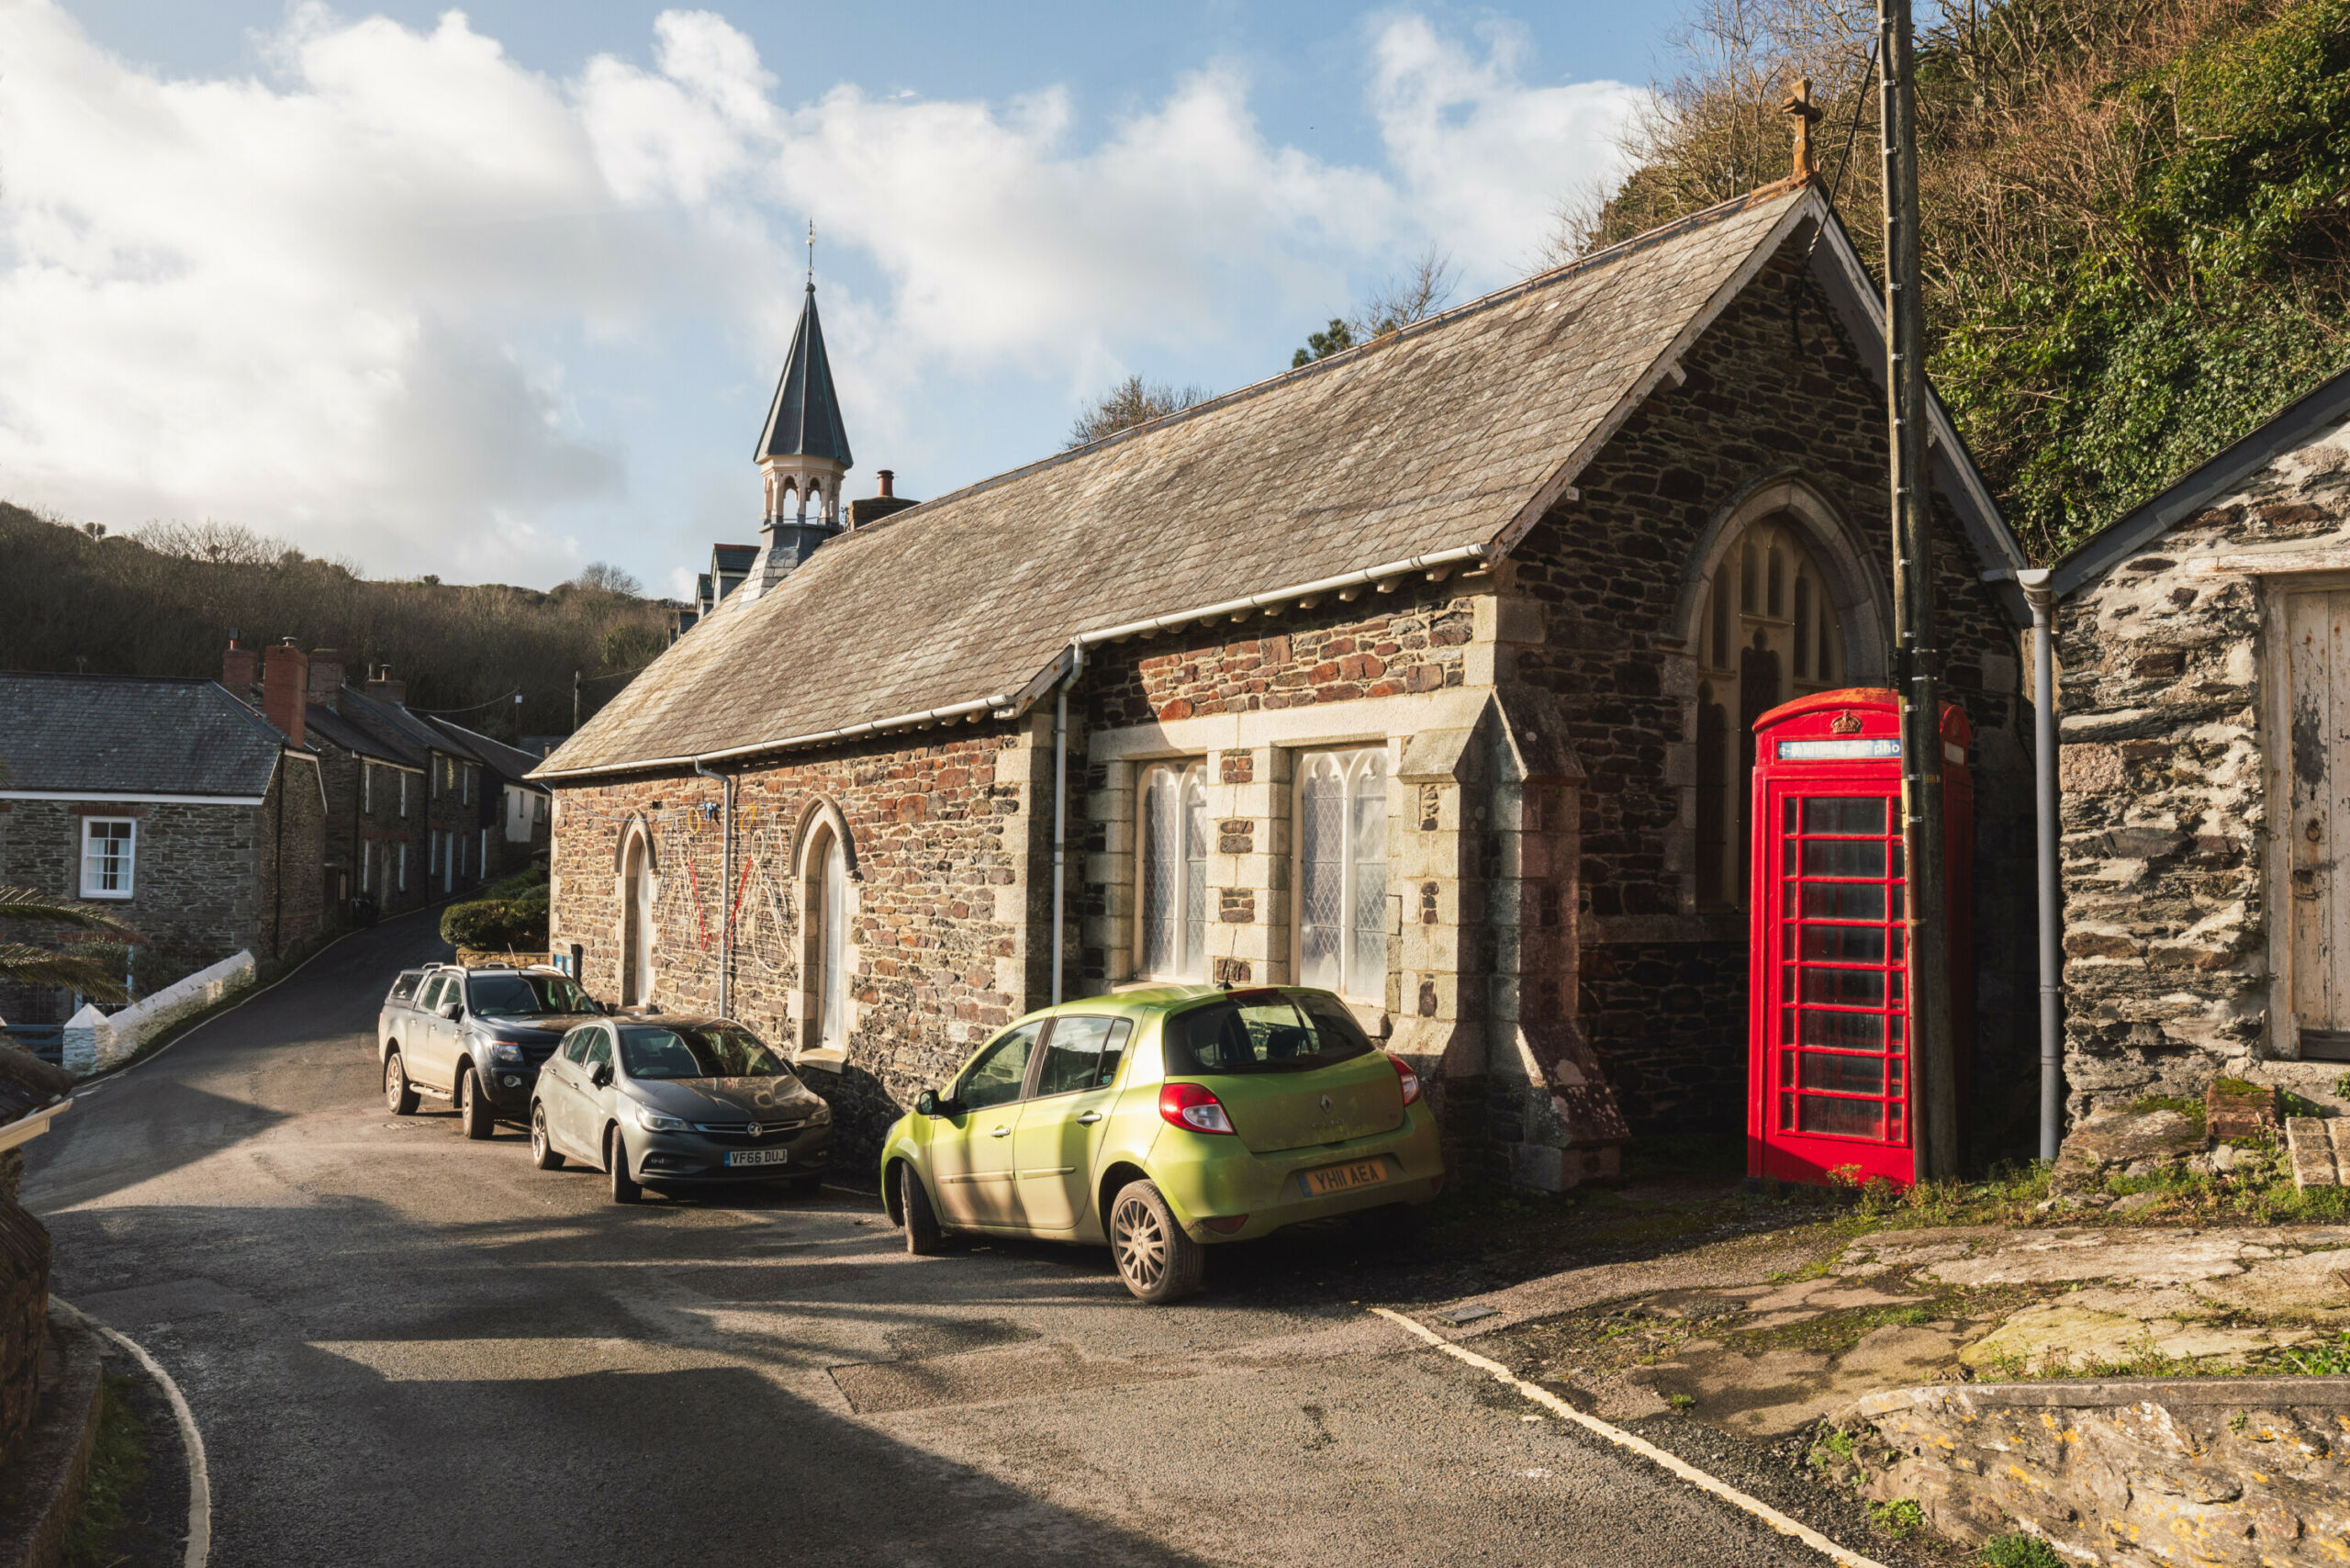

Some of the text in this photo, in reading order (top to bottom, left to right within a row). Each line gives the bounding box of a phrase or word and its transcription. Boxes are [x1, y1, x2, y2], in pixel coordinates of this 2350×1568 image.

[1874, 740, 1900, 756] pho
[732, 1150, 786, 1164] VF66 DUJ
[1315, 1162, 1380, 1190] YH11 AEA
